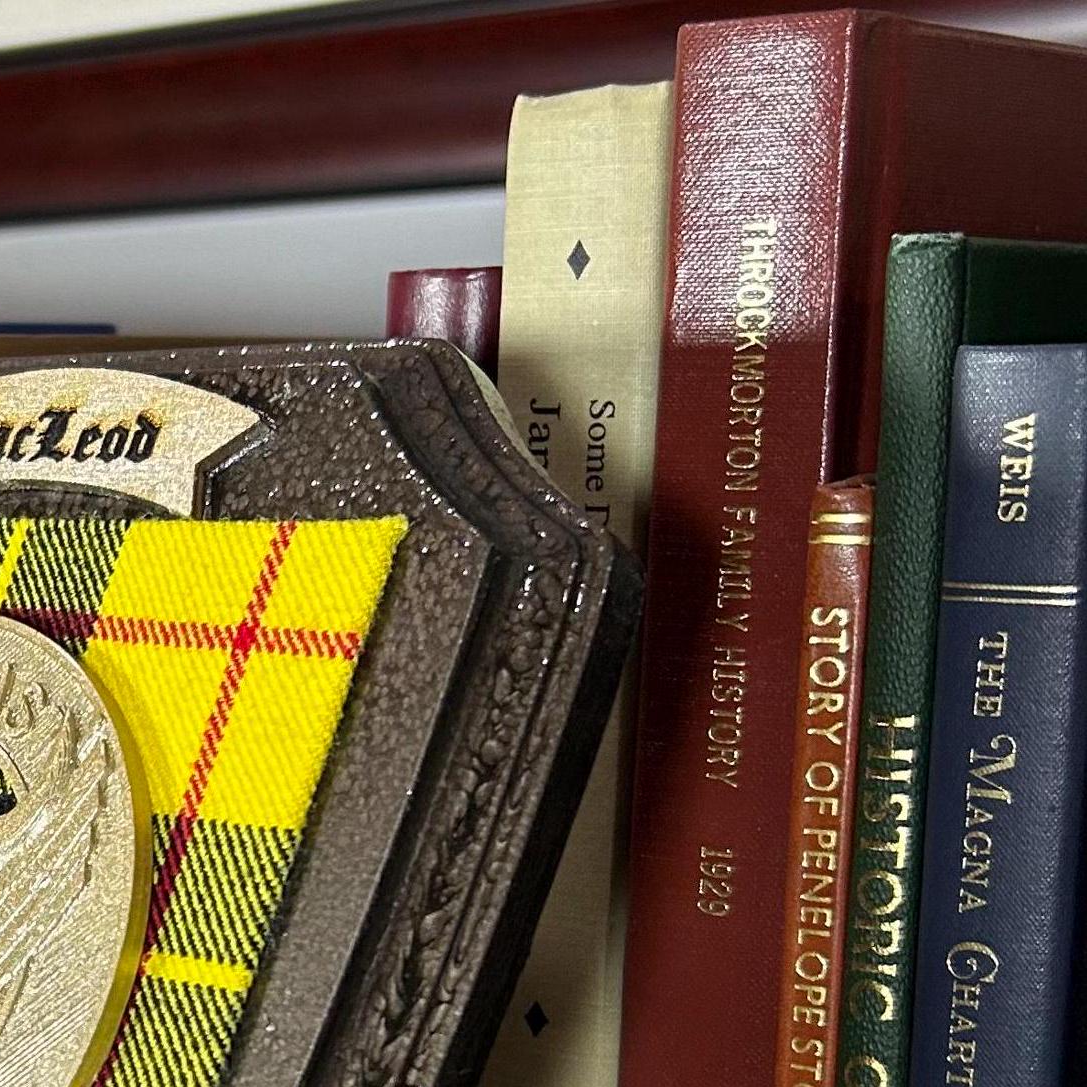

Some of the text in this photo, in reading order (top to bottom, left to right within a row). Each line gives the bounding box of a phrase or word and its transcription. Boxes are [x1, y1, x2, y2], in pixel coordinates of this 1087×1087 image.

[585, 399, 616, 491] Some
[997, 412, 1038, 523] WEIS
[697, 216, 777, 918] THROCKMORTON FAMILY HISTORY 1929
[807, 606, 851, 746] STORY
[973, 631, 1009, 717] THE
[803, 761, 842, 817] OF
[957, 733, 1017, 915] MAGNA
[793, 827, 838, 1028] PENELOPE
[849, 714, 917, 1022] HISTORIC
